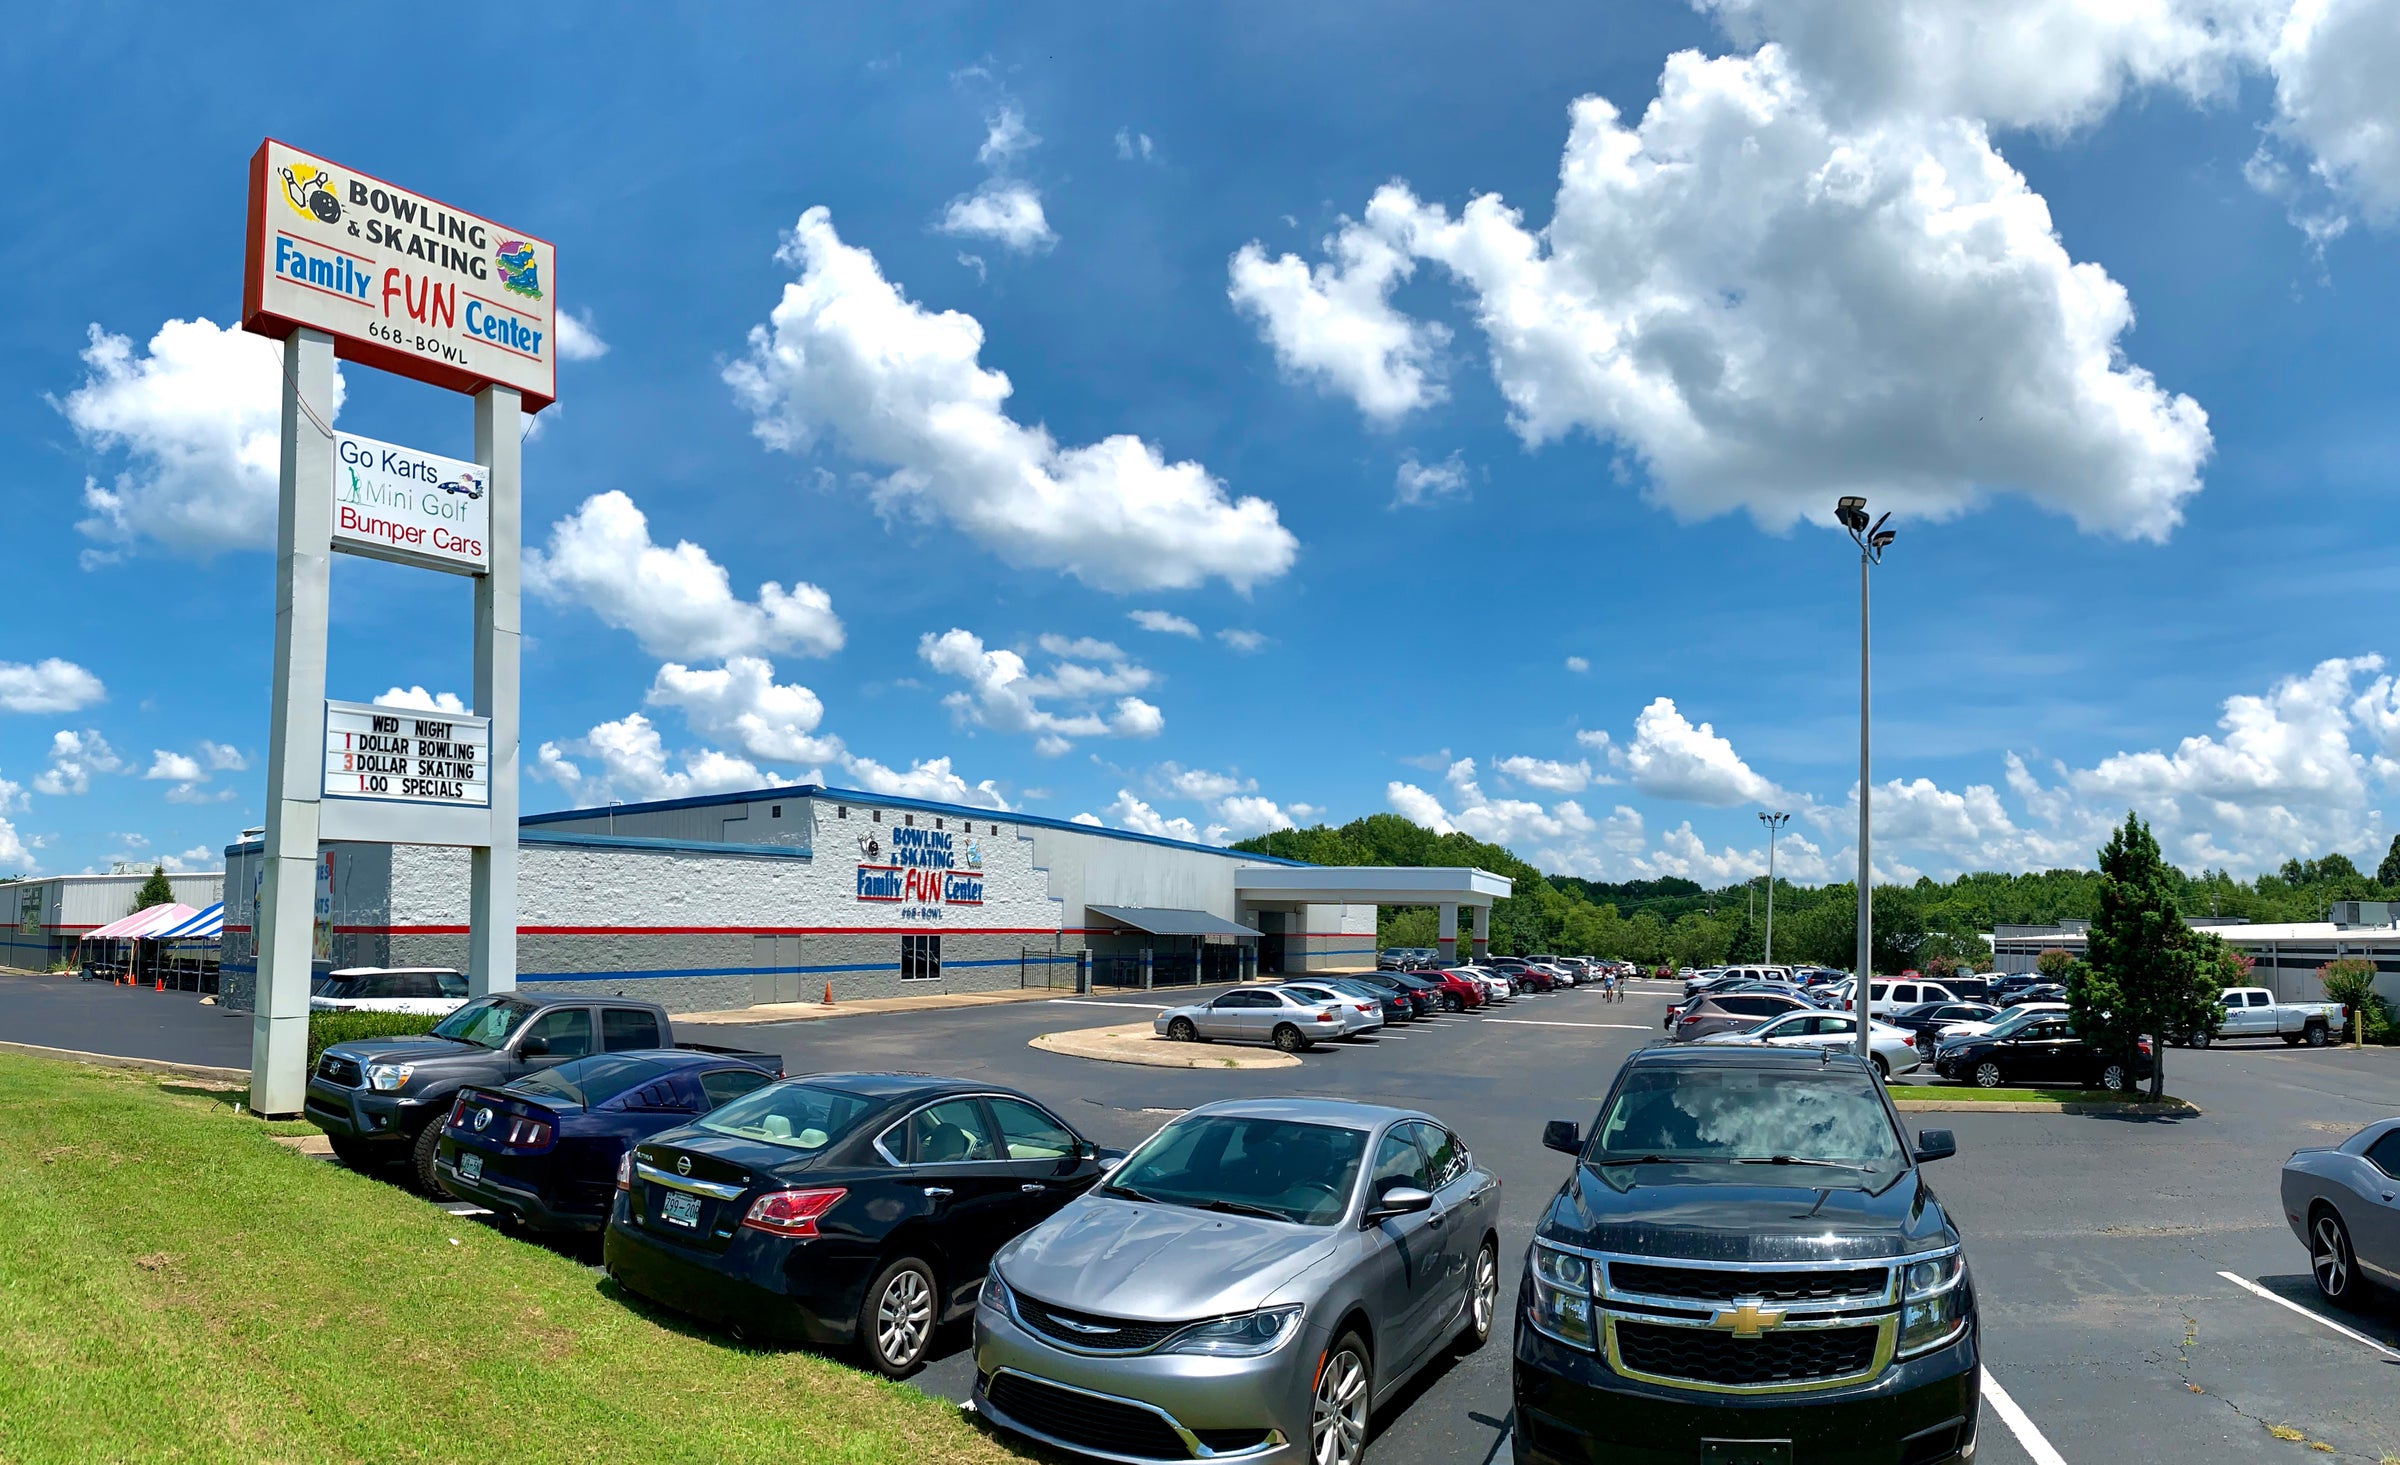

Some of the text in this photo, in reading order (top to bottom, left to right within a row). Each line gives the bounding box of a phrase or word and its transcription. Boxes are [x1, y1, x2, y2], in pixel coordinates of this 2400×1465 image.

[349, 179, 486, 250] BOWLING
[347, 219, 487, 280] & SKATING
[275, 236, 542, 354] Family FUN Center
[369, 321, 468, 364] 668-BOWL
[340, 441, 438, 483] Go Karts
[366, 480, 468, 522] Mini Golf
[340, 506, 482, 556] Bumper Cars
[372, 715, 453, 739] WED NIGHT
[345, 732, 475, 760] 1 DOLLAR BOWLING
[344, 753, 474, 779] 3 DOLLAR SKATING
[359, 775, 463, 798] 1.00 SPECIALS
[893, 827, 952, 850] BOWLING
[900, 848, 955, 869] SKATING
[857, 868, 983, 903] Family FUN Center
[901, 907, 943, 920] 668-BOWL
